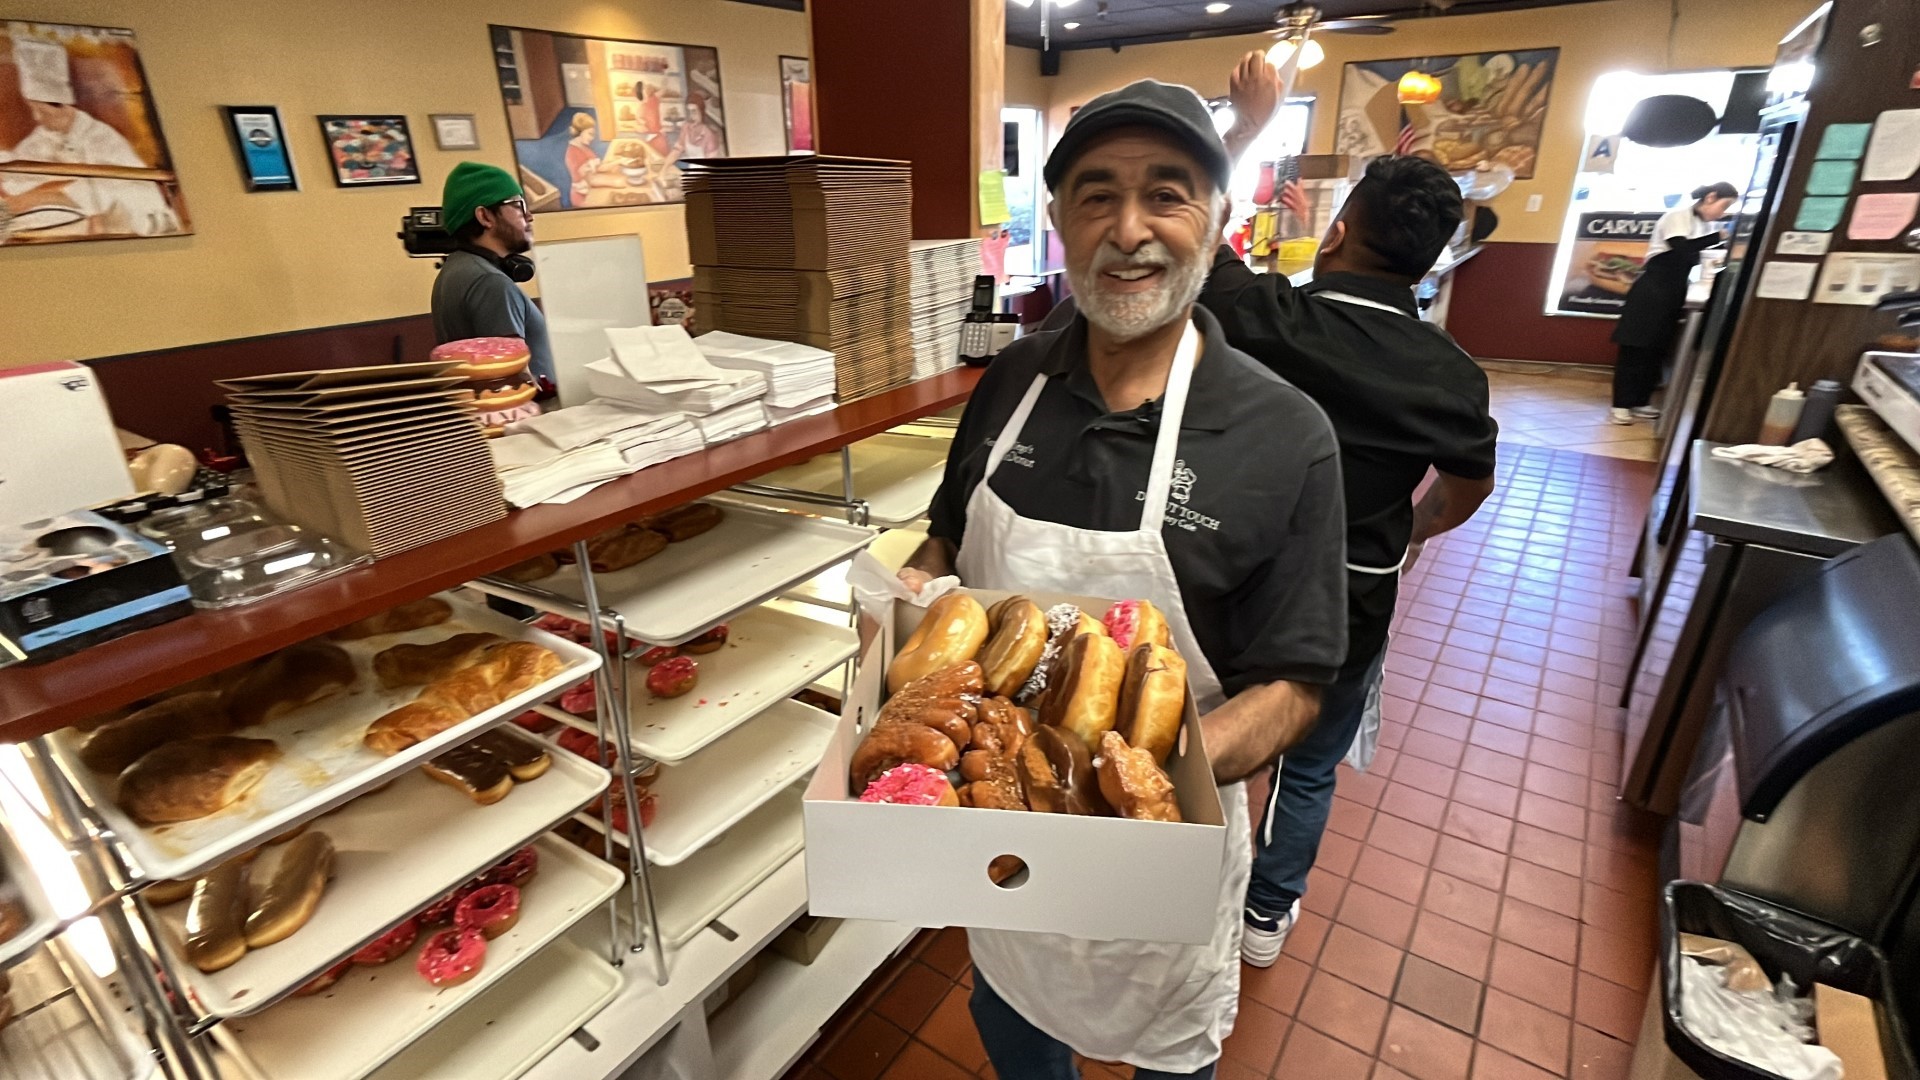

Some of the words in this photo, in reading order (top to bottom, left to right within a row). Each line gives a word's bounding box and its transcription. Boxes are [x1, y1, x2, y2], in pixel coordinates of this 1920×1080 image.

[1592, 138, 1611, 157] A
[1587, 218, 1656, 235] CARVE
[1178, 505, 1221, 531] TOUCH
